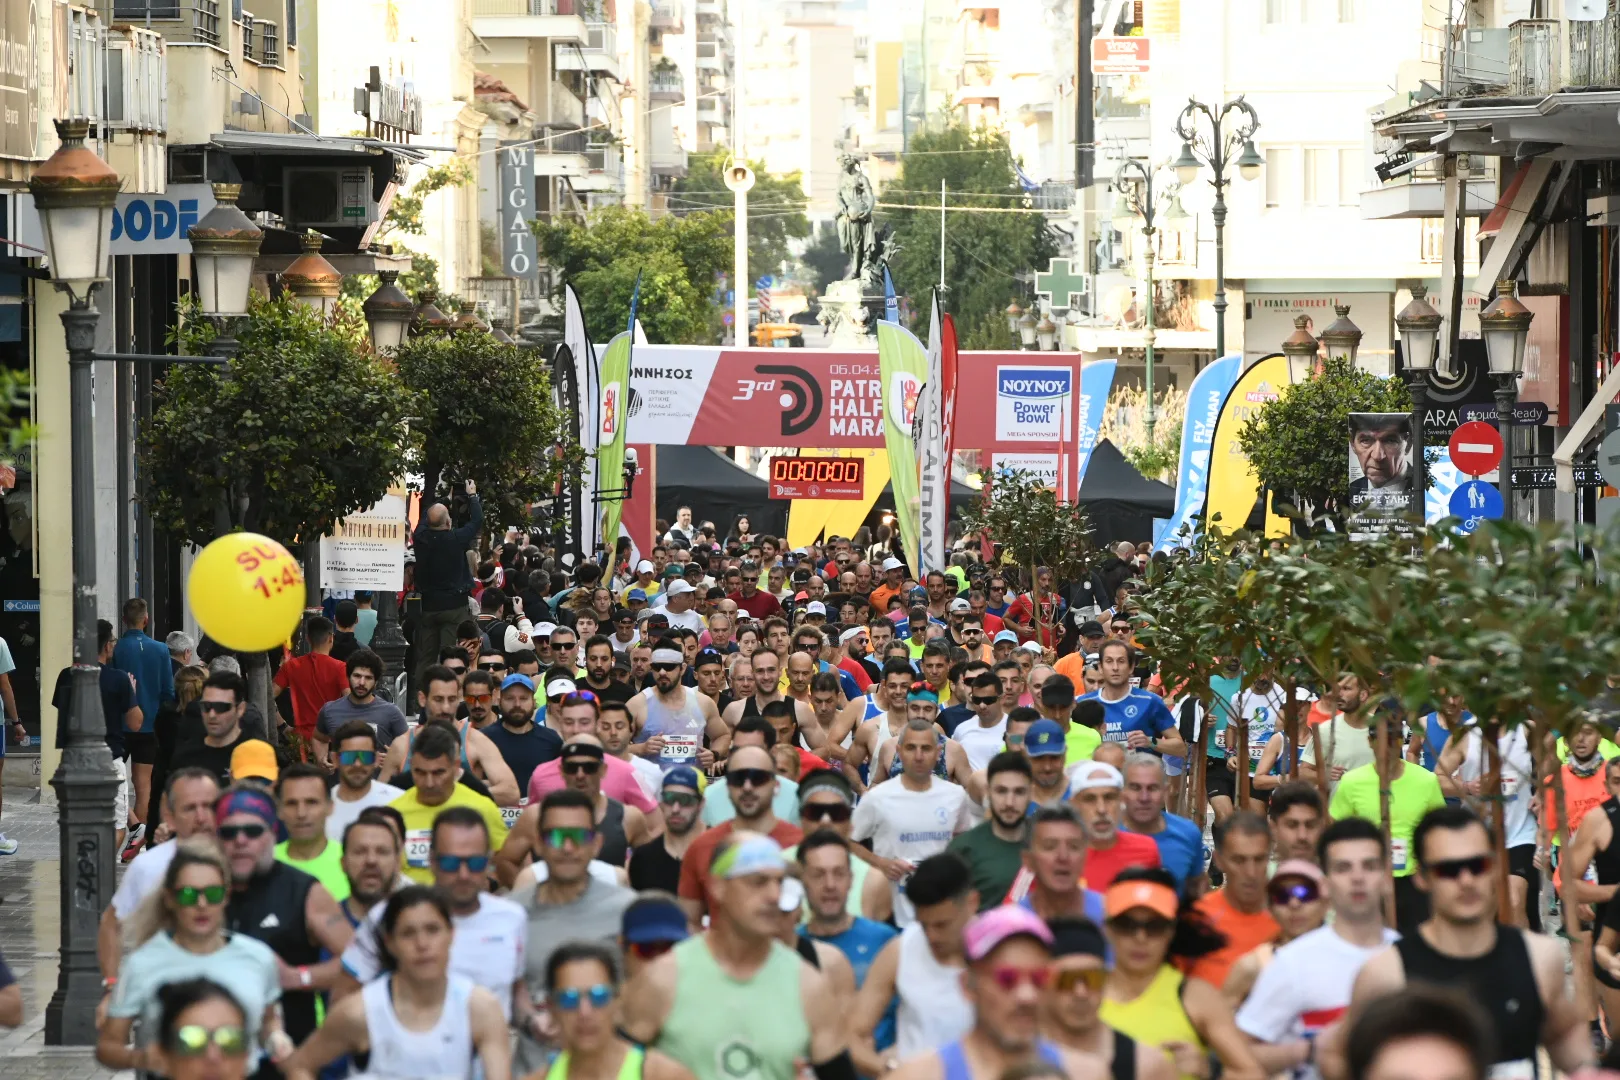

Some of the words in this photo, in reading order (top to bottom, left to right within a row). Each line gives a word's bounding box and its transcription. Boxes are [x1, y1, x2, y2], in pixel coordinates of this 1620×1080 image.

[507, 147, 530, 273] MIGATO
[732, 380, 775, 400] 3rd
[603, 390, 613, 433] Dole
[830, 399, 883, 417] HALF
[1014, 402, 1055, 413] Power
[1016, 411, 1050, 423] Bowl
[1204, 391, 1220, 444] HUMAN
[1193, 420, 1205, 443] FLY
[774, 461, 858, 482] 00:00:00
[1106, 721, 1122, 731] MAX
[664, 746, 688, 754] 2190
